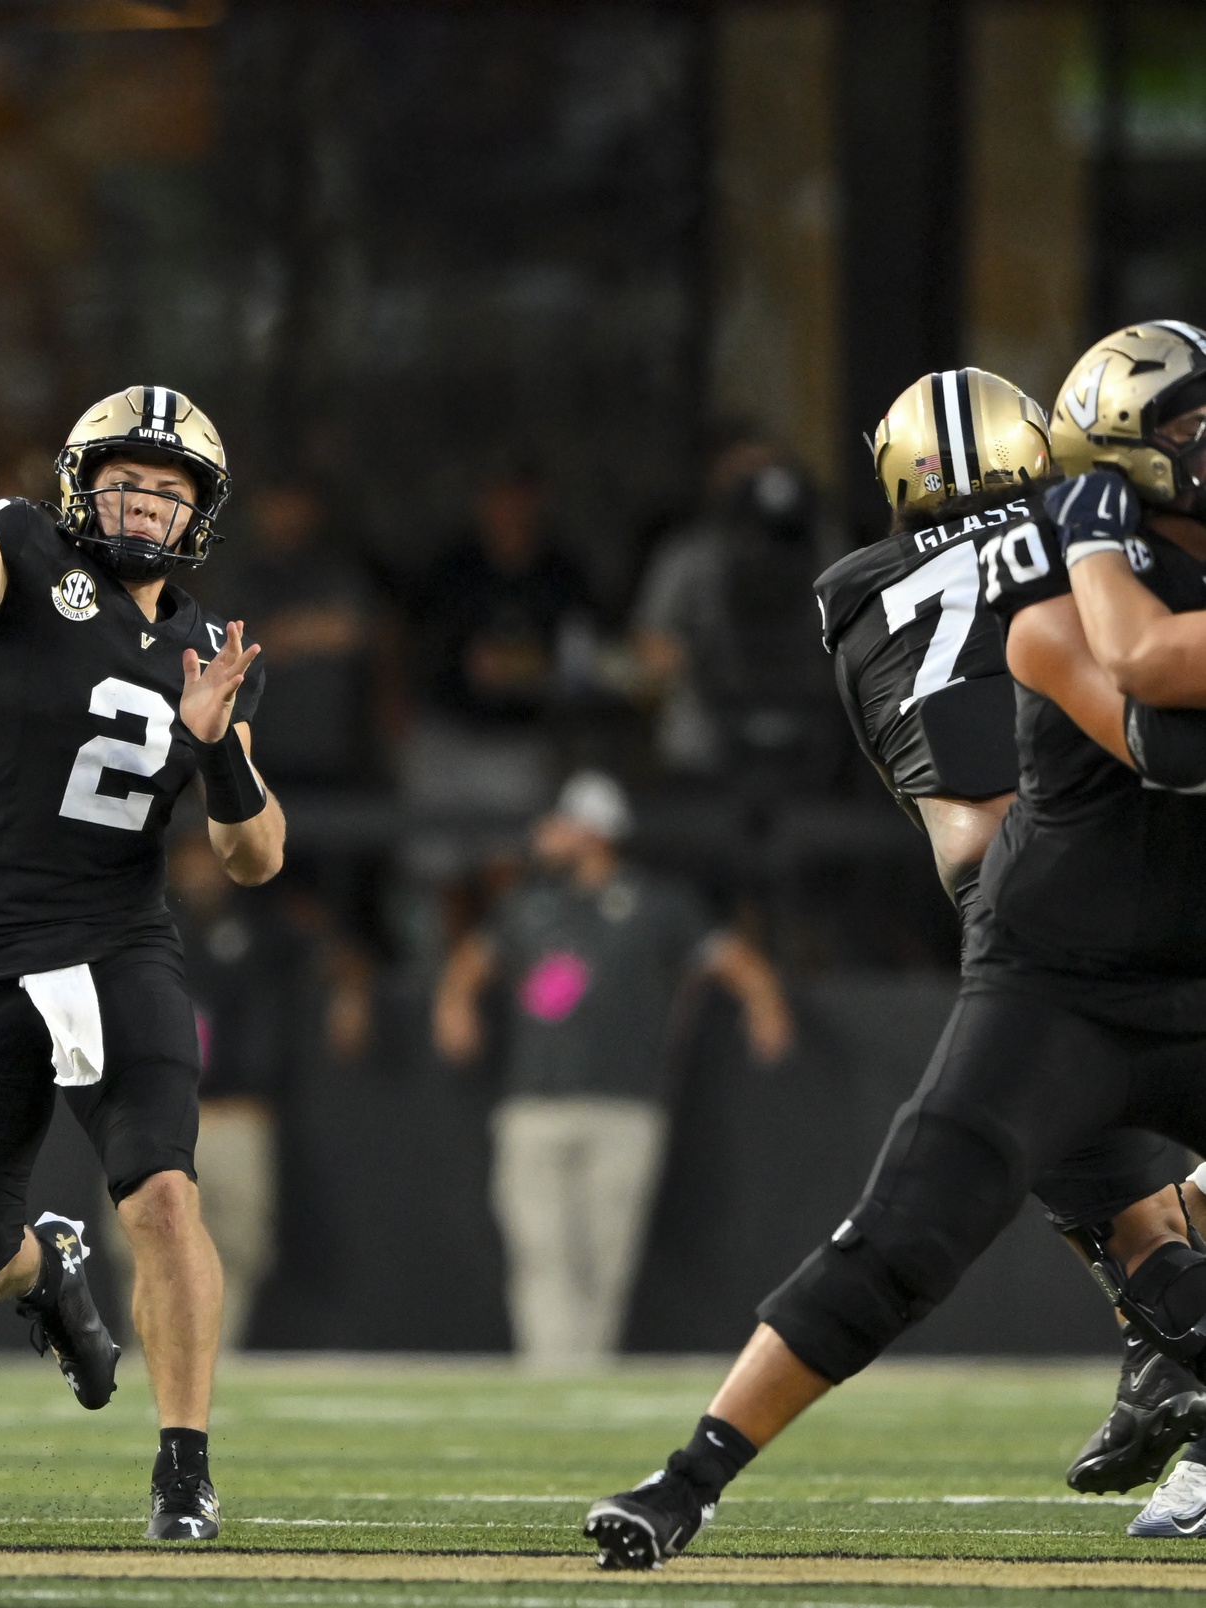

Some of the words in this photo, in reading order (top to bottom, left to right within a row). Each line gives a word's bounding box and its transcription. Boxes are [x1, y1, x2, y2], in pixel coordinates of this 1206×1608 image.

[924, 473, 942, 492] SEC
[914, 499, 1030, 553] GLASS
[979, 521, 1050, 605] 70
[1124, 538, 1151, 572] EC
[54, 596, 91, 619] GRADUATE
[62, 572, 94, 608] SEC
[140, 631, 156, 650] V
[58, 677, 176, 831] 2
